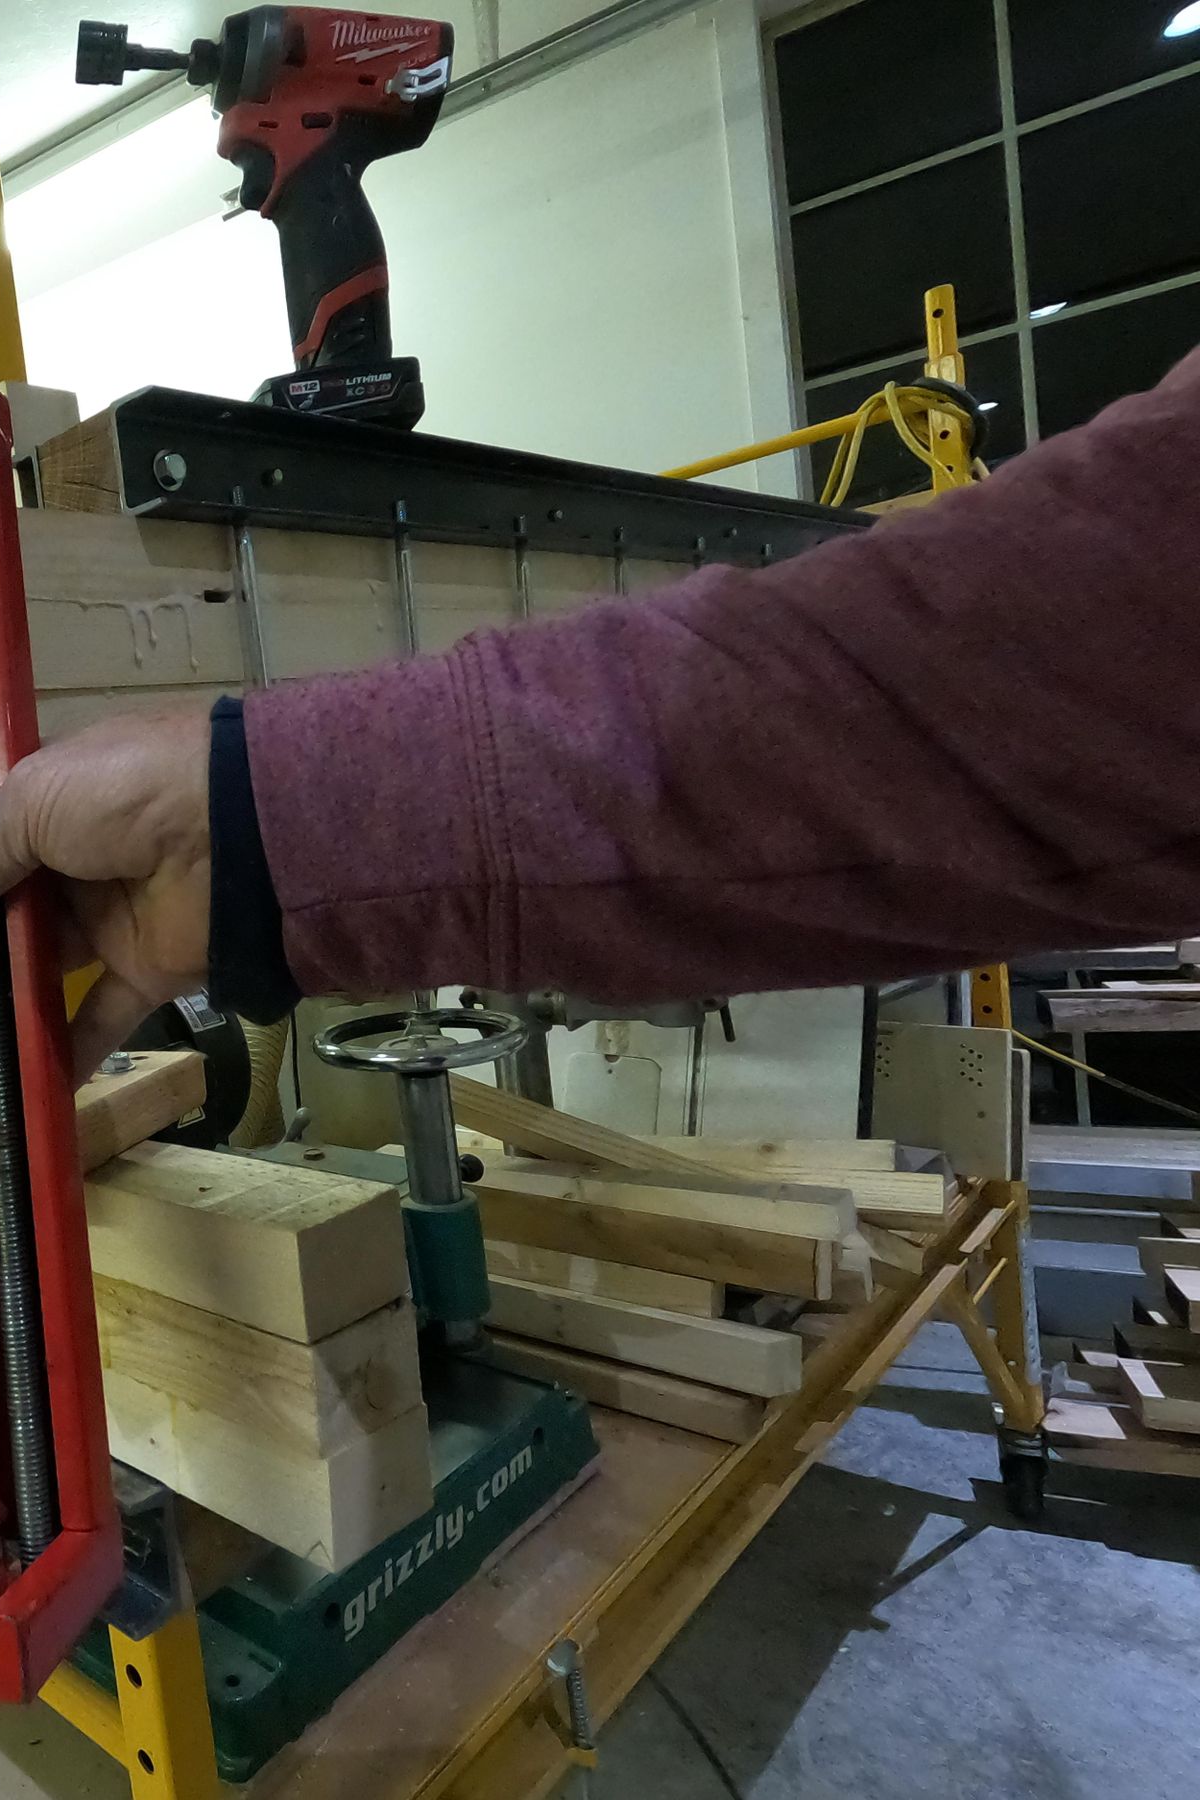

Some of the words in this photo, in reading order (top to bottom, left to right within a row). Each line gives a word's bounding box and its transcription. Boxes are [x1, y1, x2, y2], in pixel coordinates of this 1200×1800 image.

[329, 20, 432, 50] Milwaukee
[291, 382, 318, 394] M12
[343, 1445, 533, 1642] grizzly.com
